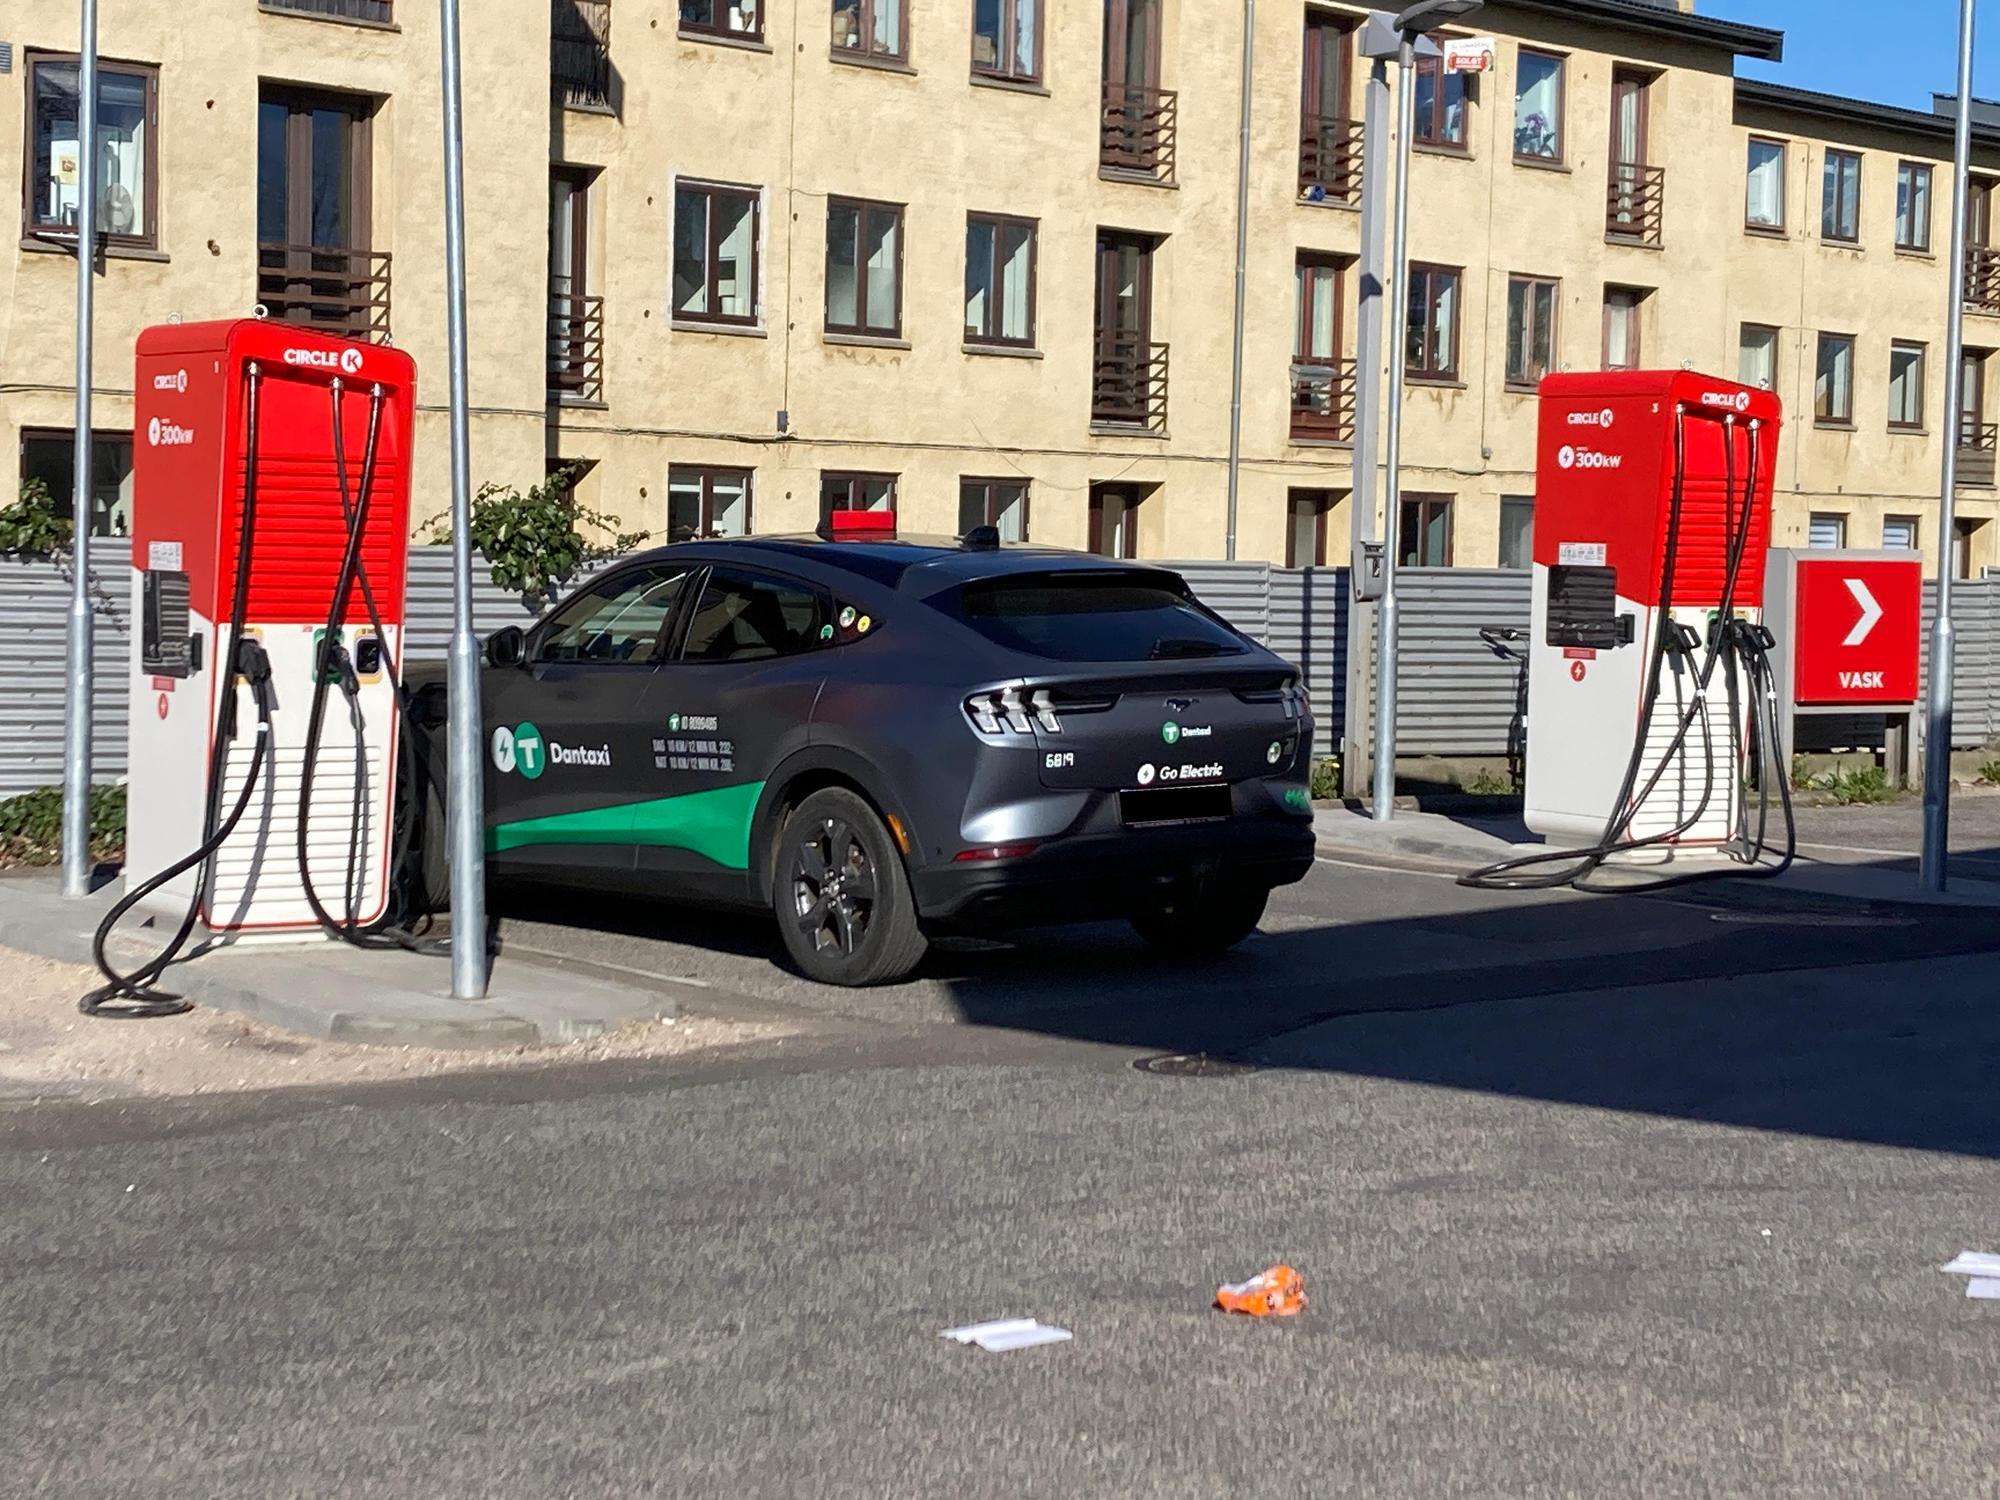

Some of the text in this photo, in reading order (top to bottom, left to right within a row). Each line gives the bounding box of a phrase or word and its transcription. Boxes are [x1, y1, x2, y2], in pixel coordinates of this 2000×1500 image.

[283, 348, 363, 373] CIRCLE K
[154, 374, 178, 390] CIRCLE
[1701, 390, 1750, 411] CIRCLE K
[1567, 408, 1613, 428] CIRCLE K
[1838, 671, 1884, 689] VASK
[550, 741, 611, 767] Dantaxi
[1045, 752, 1074, 769] 6819
[1159, 762, 1223, 780] Go Electric
